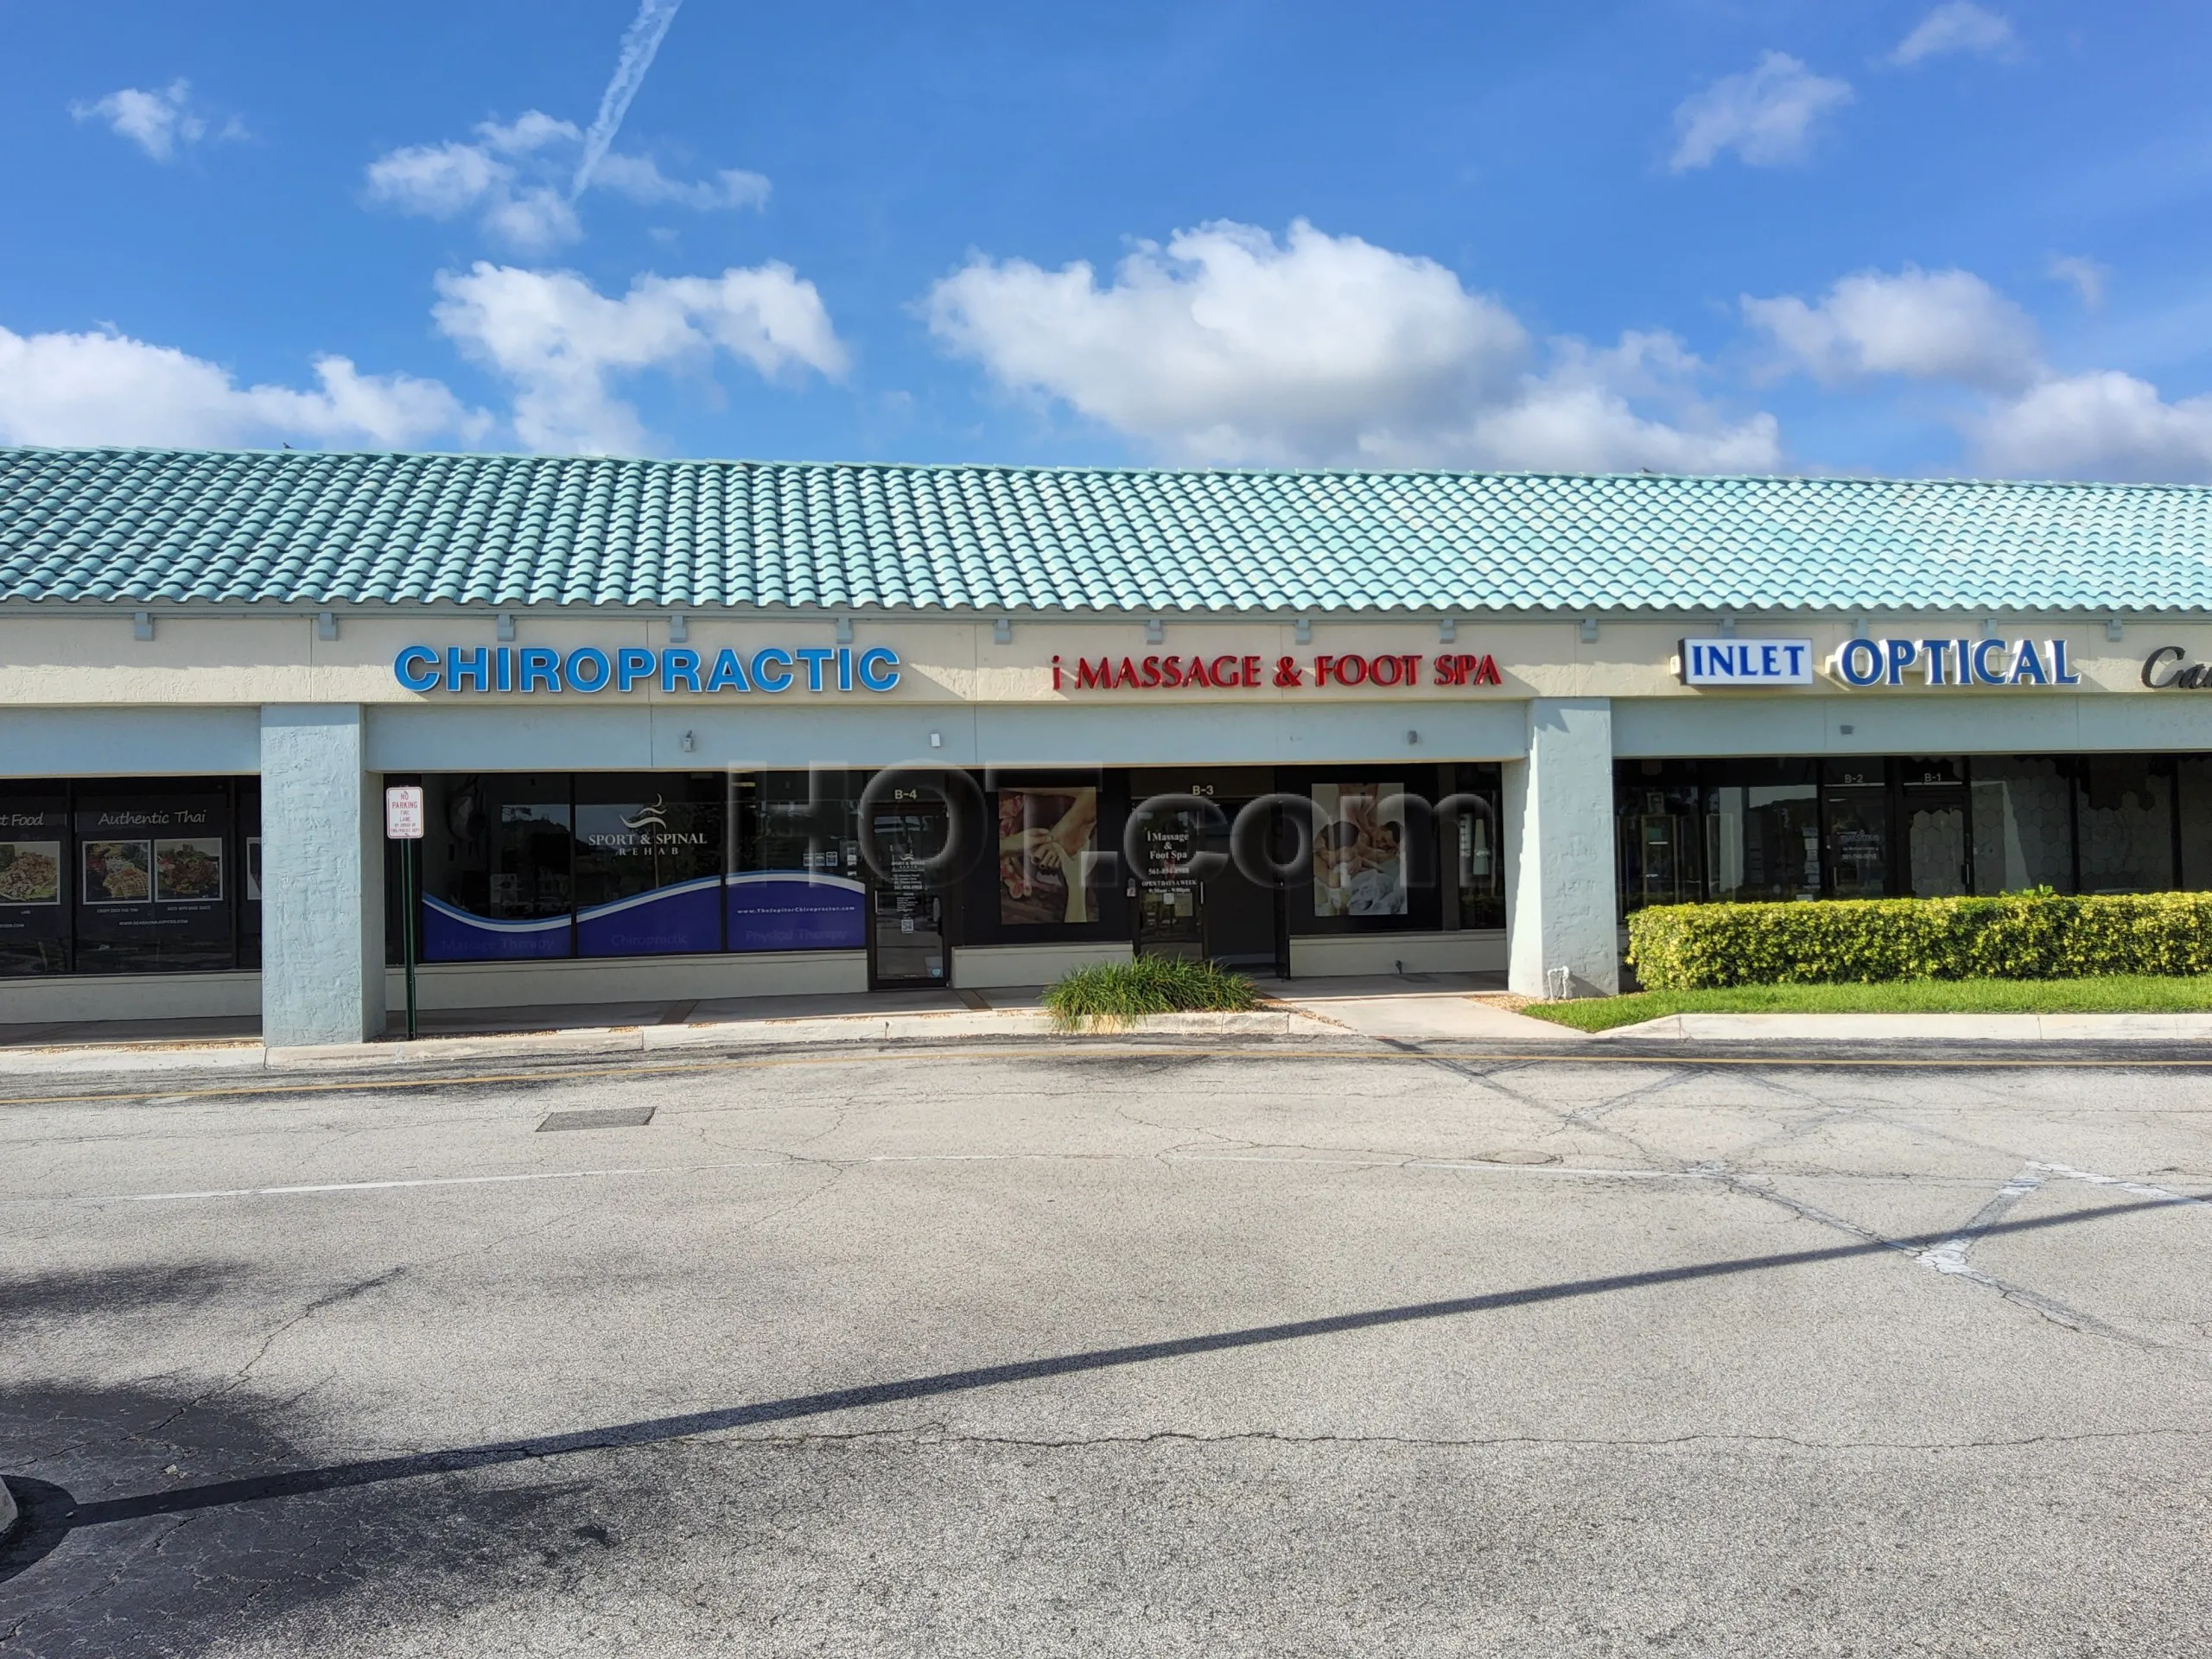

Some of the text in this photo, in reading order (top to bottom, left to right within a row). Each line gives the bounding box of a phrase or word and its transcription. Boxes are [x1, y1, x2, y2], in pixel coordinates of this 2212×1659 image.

[1691, 639, 2081, 686] INLET OPTICAL
[393, 645, 900, 693] CHIROPRACTIC
[1052, 654, 1502, 690] i MASSAGE & FOOT SPA
[1844, 774, 1864, 783] B-2
[1924, 772, 1942, 781] B-1
[894, 789, 917, 800] B-4
[1192, 785, 1214, 795] B-3
[11, 812, 43, 826] Food
[98, 809, 207, 825] Authentic Thai
[588, 833, 708, 845] SPORT & SPINAL
[1153, 832, 1189, 842] Massage
[619, 847, 679, 855] REHAB
[1150, 850, 1187, 861] Foot Spa
[611, 933, 689, 947] Chiropractic
